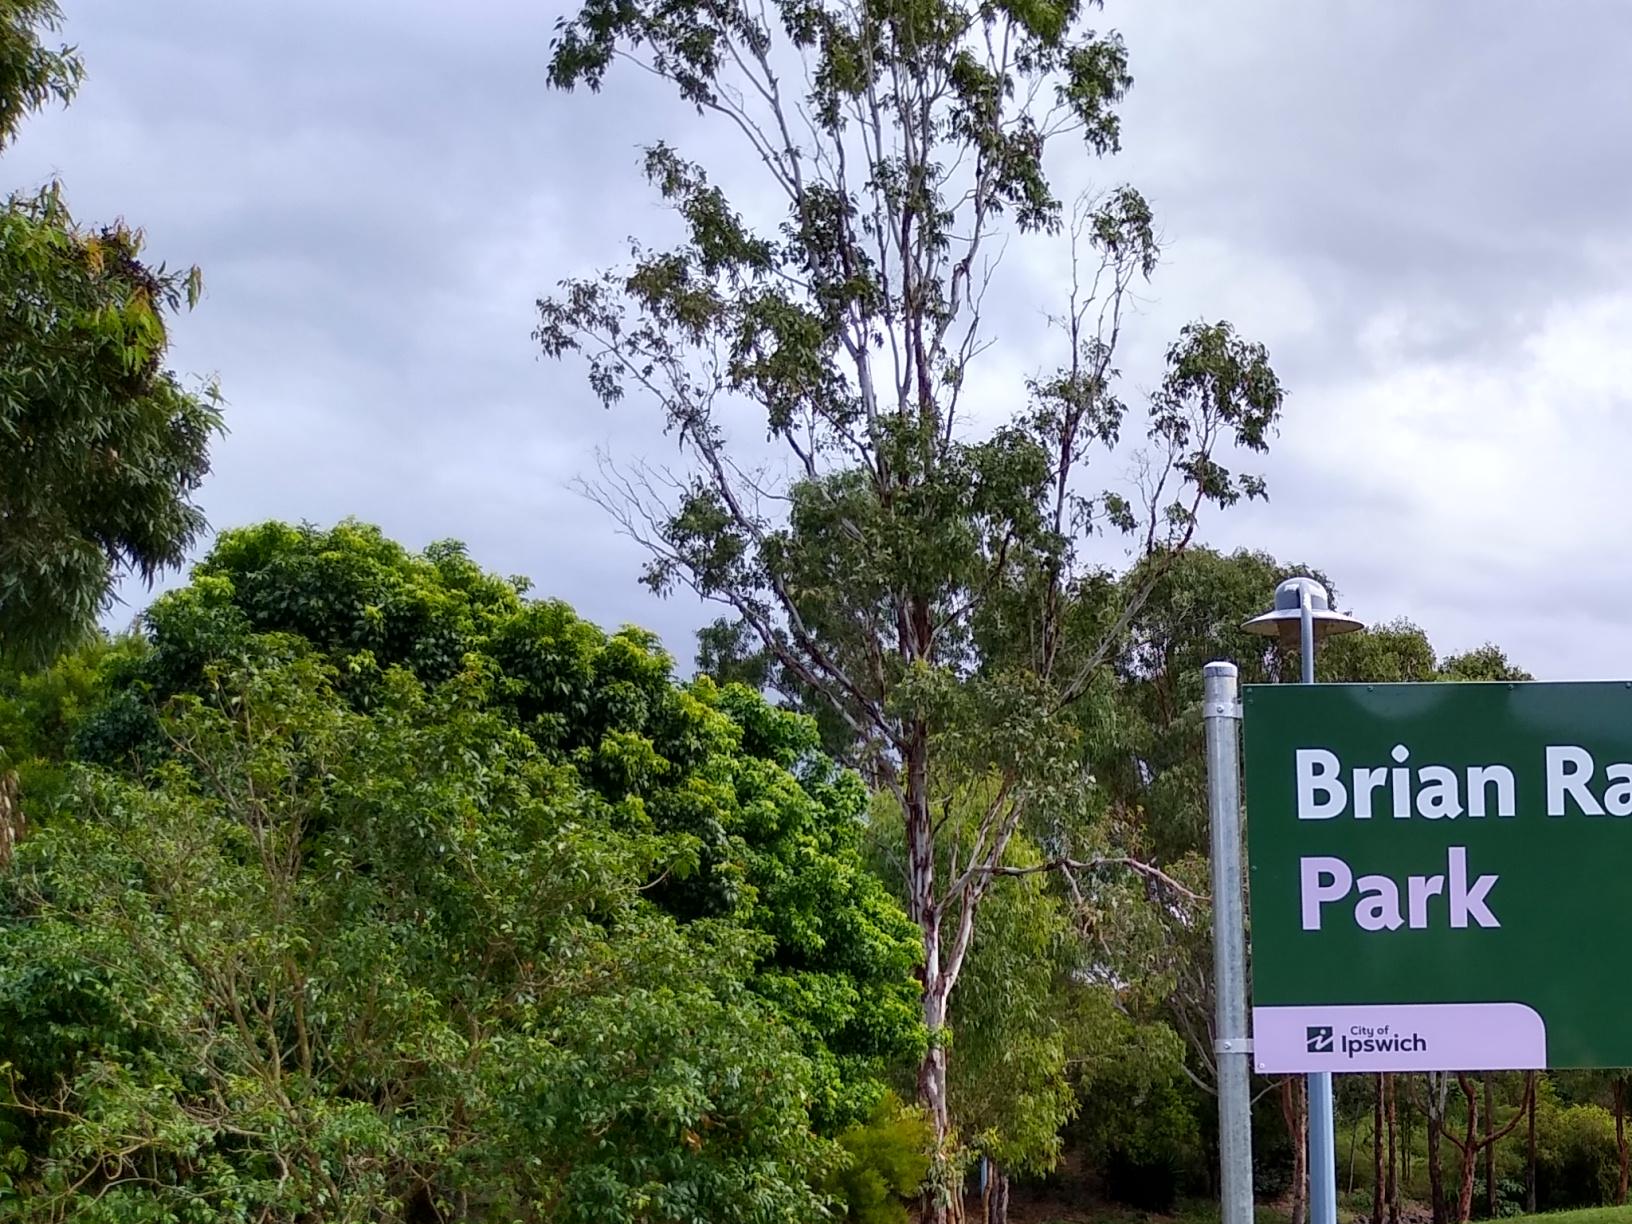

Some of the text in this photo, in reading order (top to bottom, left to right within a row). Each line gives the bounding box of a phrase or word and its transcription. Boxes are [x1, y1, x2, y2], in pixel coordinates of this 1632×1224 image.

[1296, 744, 1516, 819] Brian
[1300, 846, 1501, 931] Park
[1341, 1033, 1427, 1058] Ipswich
[1350, 1024, 1389, 1038] City of
